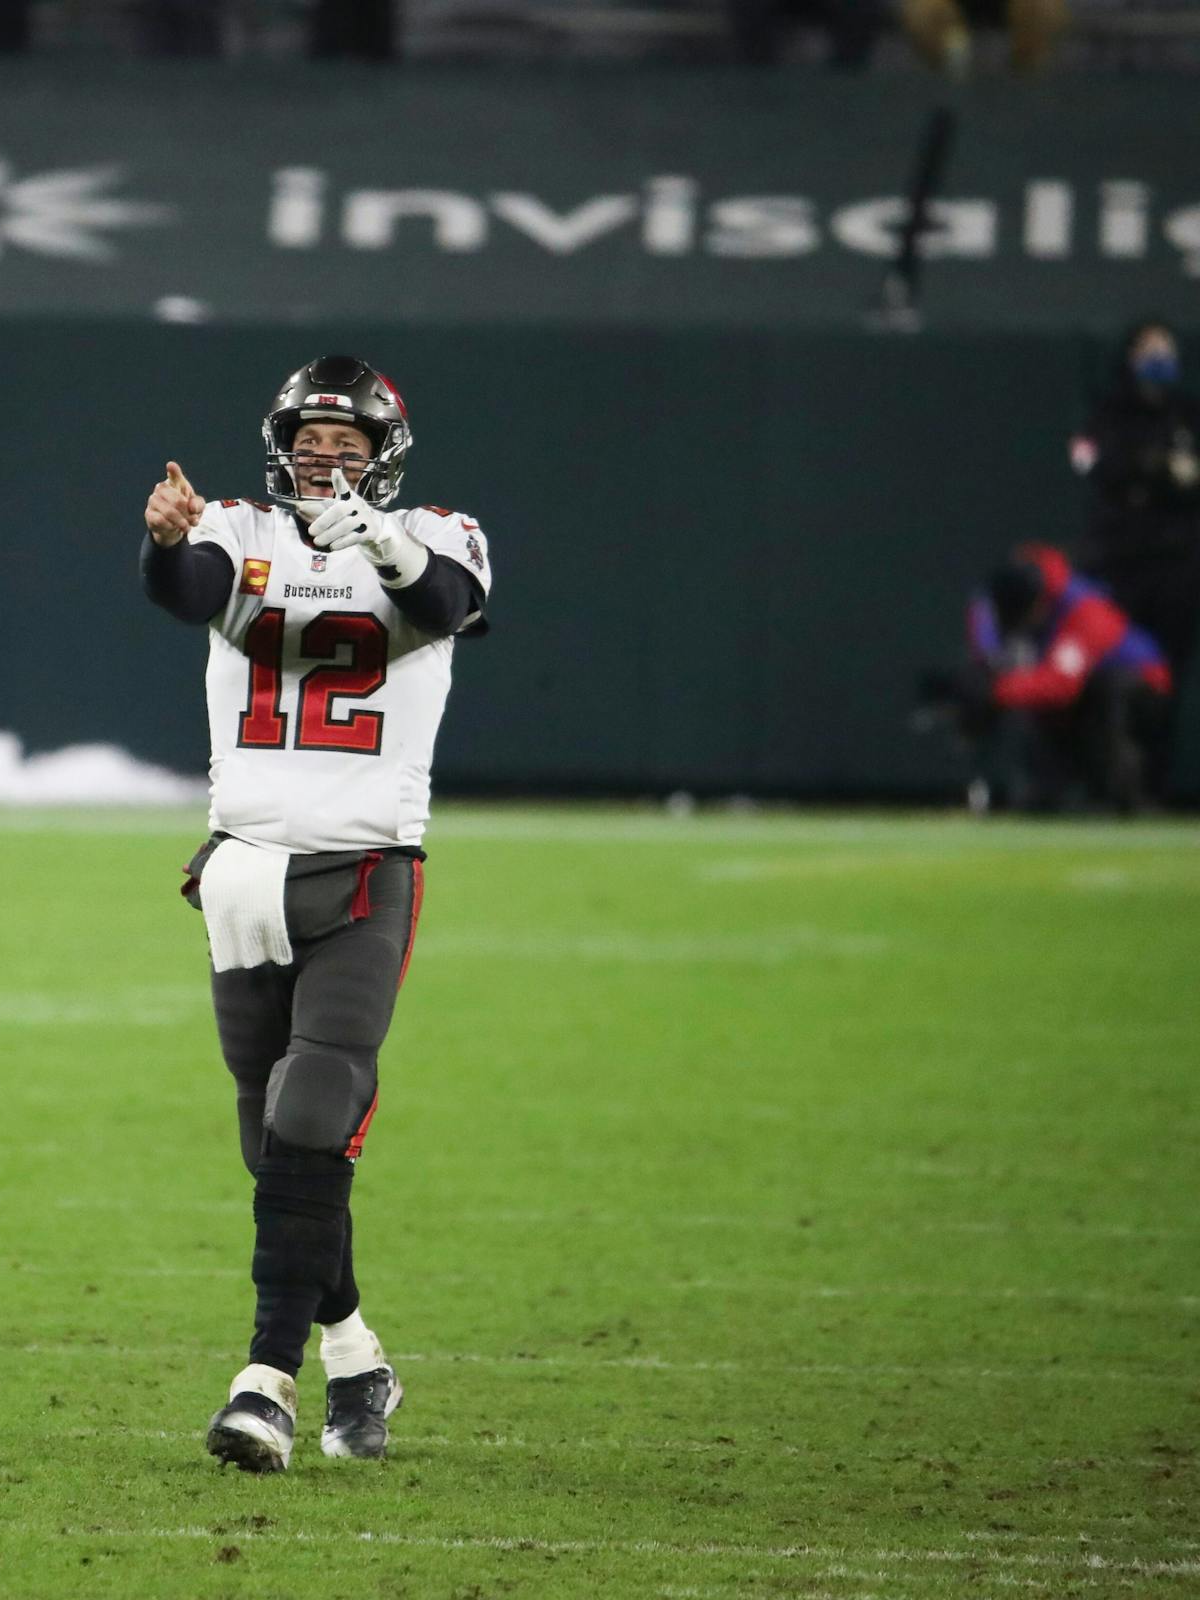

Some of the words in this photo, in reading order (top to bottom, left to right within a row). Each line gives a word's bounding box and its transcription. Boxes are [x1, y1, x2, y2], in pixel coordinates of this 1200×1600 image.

[267, 167, 1200, 277] invisali
[283, 584, 353, 600] BUCCANEERS
[236, 606, 390, 756] 12
